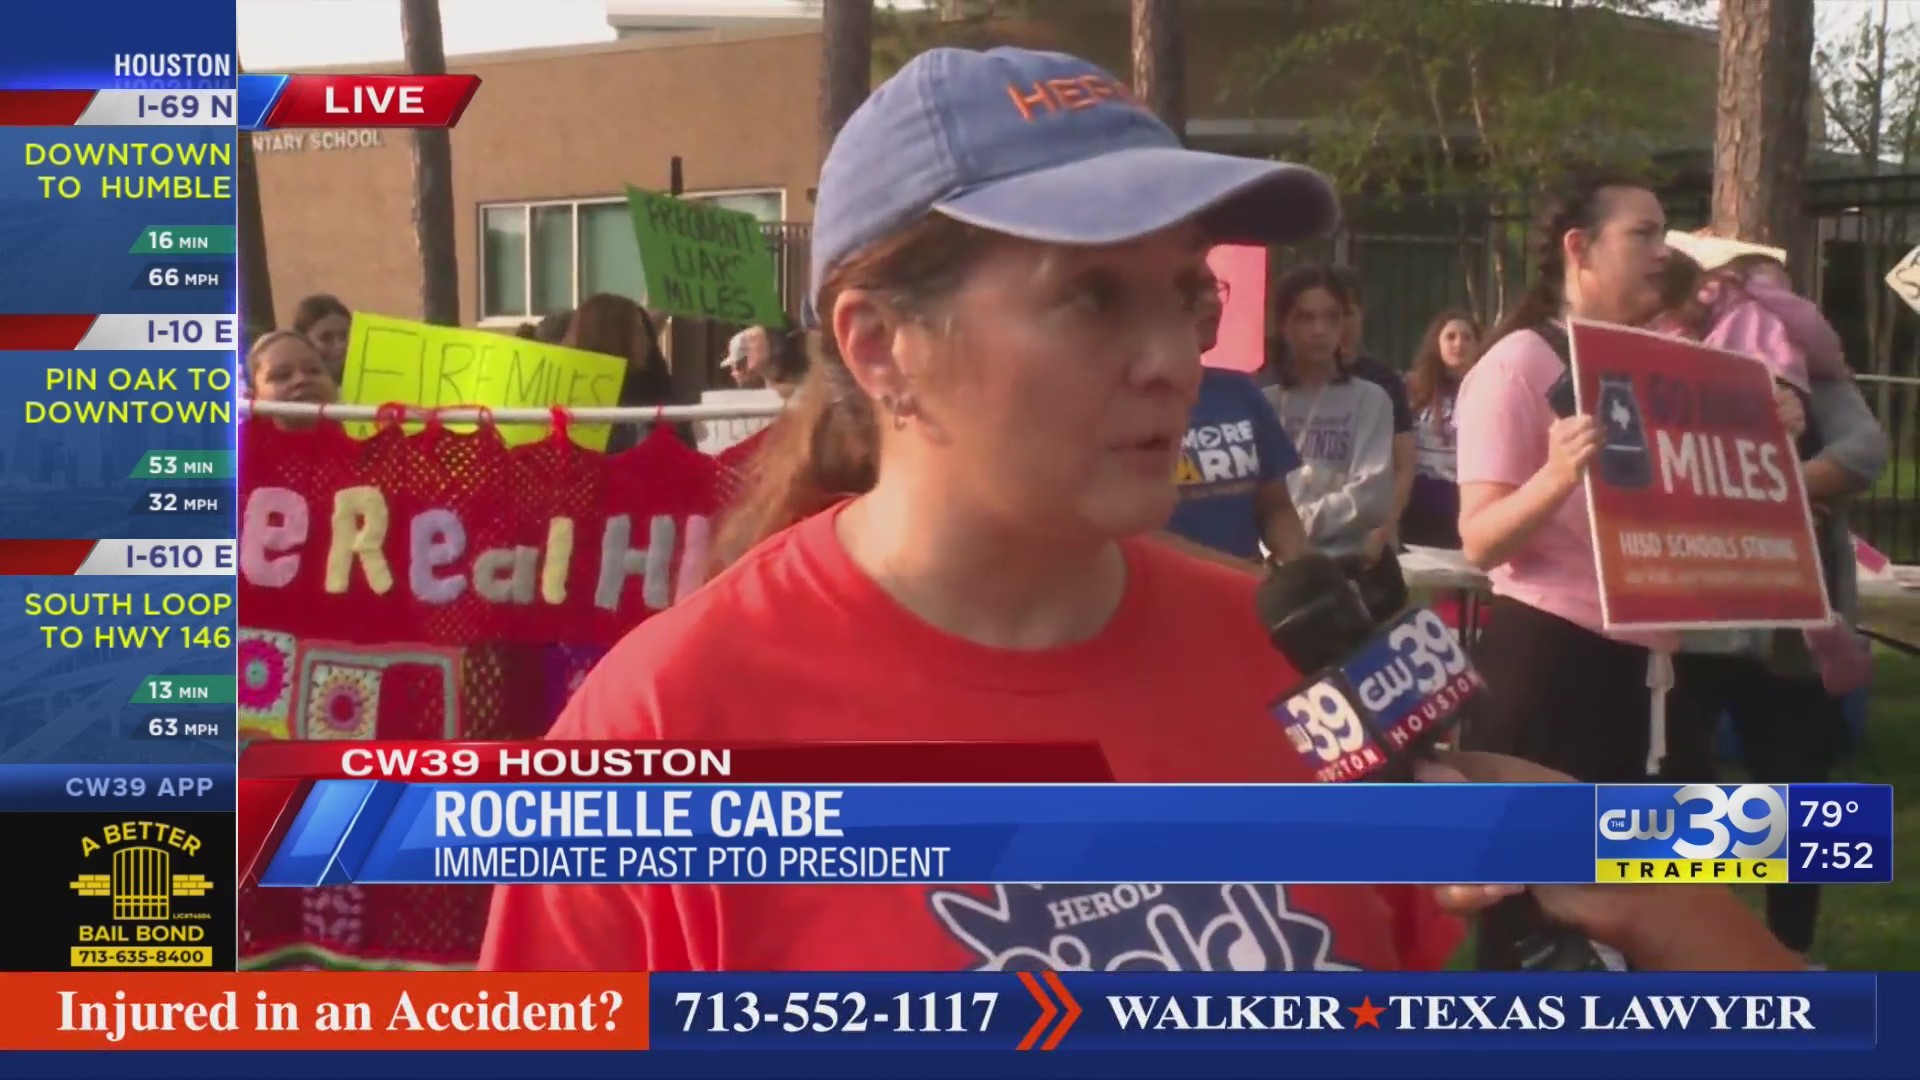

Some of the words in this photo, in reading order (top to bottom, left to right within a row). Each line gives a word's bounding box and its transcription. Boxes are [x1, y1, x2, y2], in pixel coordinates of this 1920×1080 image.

[310, 129, 382, 149] SCHOOL
[662, 273, 756, 319] MILES
[354, 326, 495, 406] FIRE
[503, 350, 614, 408] MILES
[1656, 430, 1788, 503] MILES
[1391, 671, 1484, 747] HOUSTON
[1047, 882, 1164, 929] HEROD
